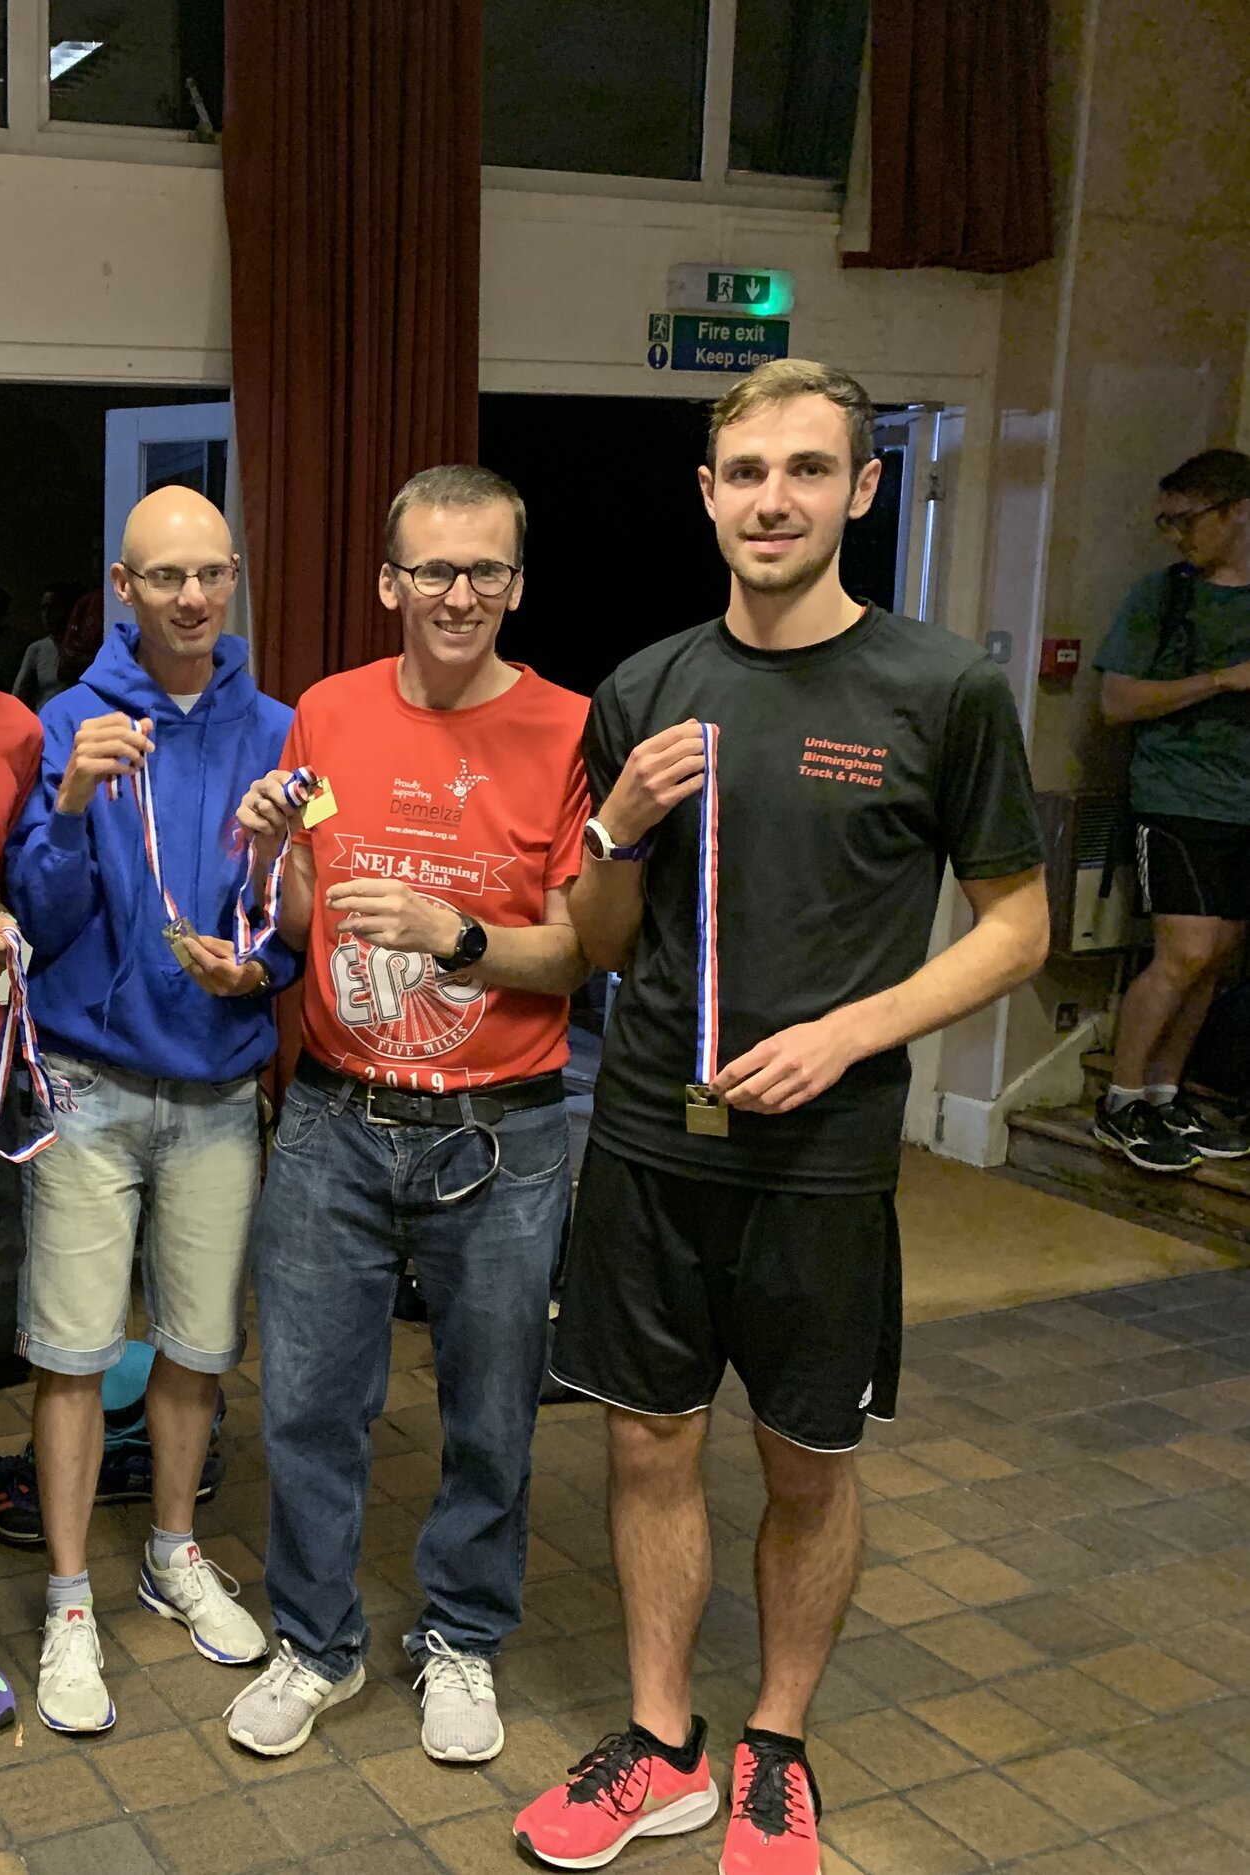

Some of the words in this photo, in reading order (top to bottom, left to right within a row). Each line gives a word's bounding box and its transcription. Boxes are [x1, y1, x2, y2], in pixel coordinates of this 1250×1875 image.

[698, 322, 730, 340] Fire
[735, 325, 765, 342] exit
[695, 347, 734, 367] Keep
[805, 737, 871, 757] University
[872, 748, 888, 757] of
[802, 751, 883, 772] Birmingham
[393, 777, 421, 790] Proudly
[799, 765, 833, 779] Track
[836, 771, 846, 781] &
[849, 772, 882, 787] Field
[391, 789, 432, 803] supporting
[390, 800, 462, 822] Demelza
[354, 852, 395, 877] NEJ
[419, 859, 480, 882] Running
[418, 872, 452, 887] Club
[377, 1041, 414, 1056] FIVE
[423, 1025, 469, 1054] MILES
[365, 1066, 445, 1094] 2019
